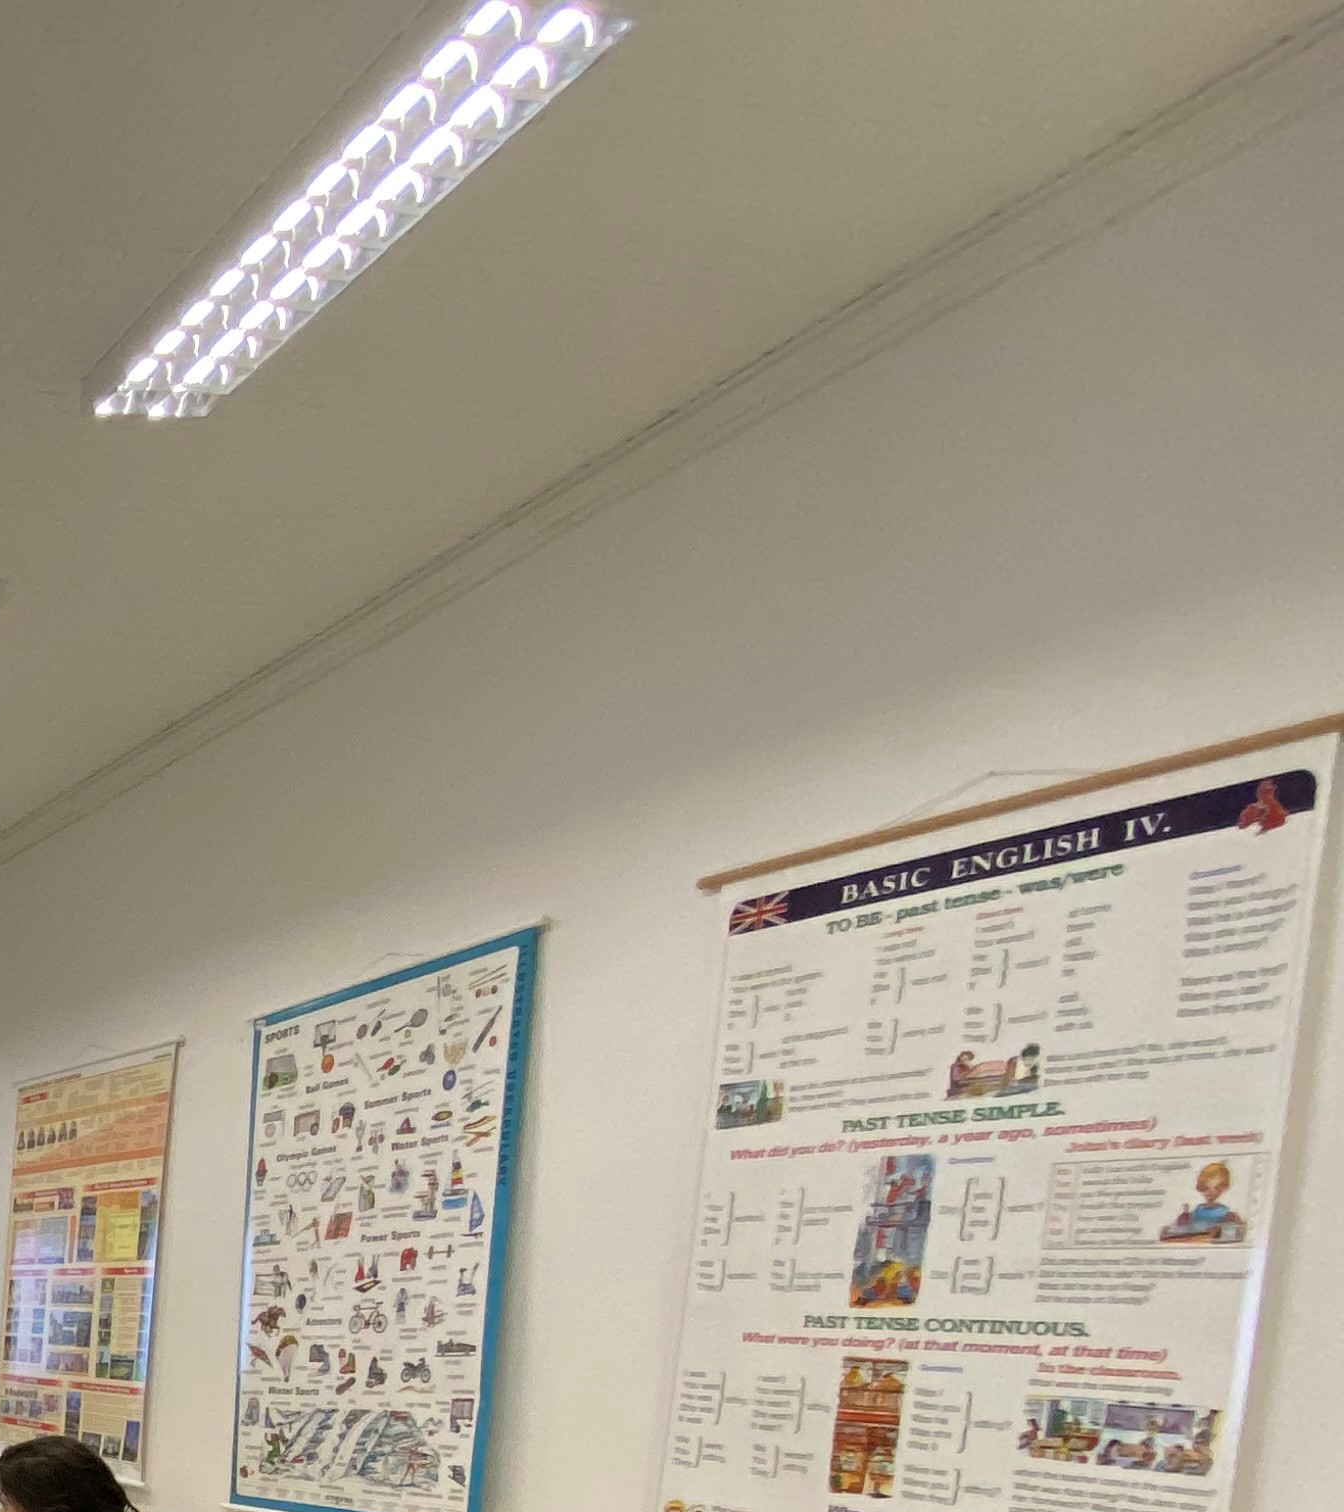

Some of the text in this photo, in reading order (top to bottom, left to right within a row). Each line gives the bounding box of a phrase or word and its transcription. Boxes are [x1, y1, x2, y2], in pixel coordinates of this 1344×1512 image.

[841, 813, 1172, 904] BASIC ENGLISH IV.
[826, 920, 851, 935] TO
[856, 912, 882, 929] BE
[896, 901, 938, 923] past
[945, 889, 1002, 909] tense
[265, 1025, 300, 1044] SPORTS
[401, 1088, 432, 1102] Sports
[842, 1116, 892, 1133] PAST
[897, 1109, 966, 1128] TENSE
[421, 1134, 449, 1147] Sports
[729, 1148, 764, 1160] What
[767, 1146, 788, 1158] did
[791, 1146, 815, 1158] you
[817, 1140, 846, 1153] do?
[954, 1131, 993, 1145] year
[276, 1151, 309, 1163] Olympic
[391, 1231, 421, 1240] Sports
[803, 1315, 1091, 1337] PAST TENSE CONTINUOUS.
[742, 1332, 775, 1345] What
[777, 1335, 810, 1346] were
[811, 1337, 838, 1348] you
[842, 1337, 895, 1351] doing?
[923, 1340, 960, 1351] that
[1048, 1345, 1068, 1356] at
[1073, 1345, 1111, 1358] that
[1116, 1347, 1167, 1363] time)
[295, 1387, 320, 1396] Sports
